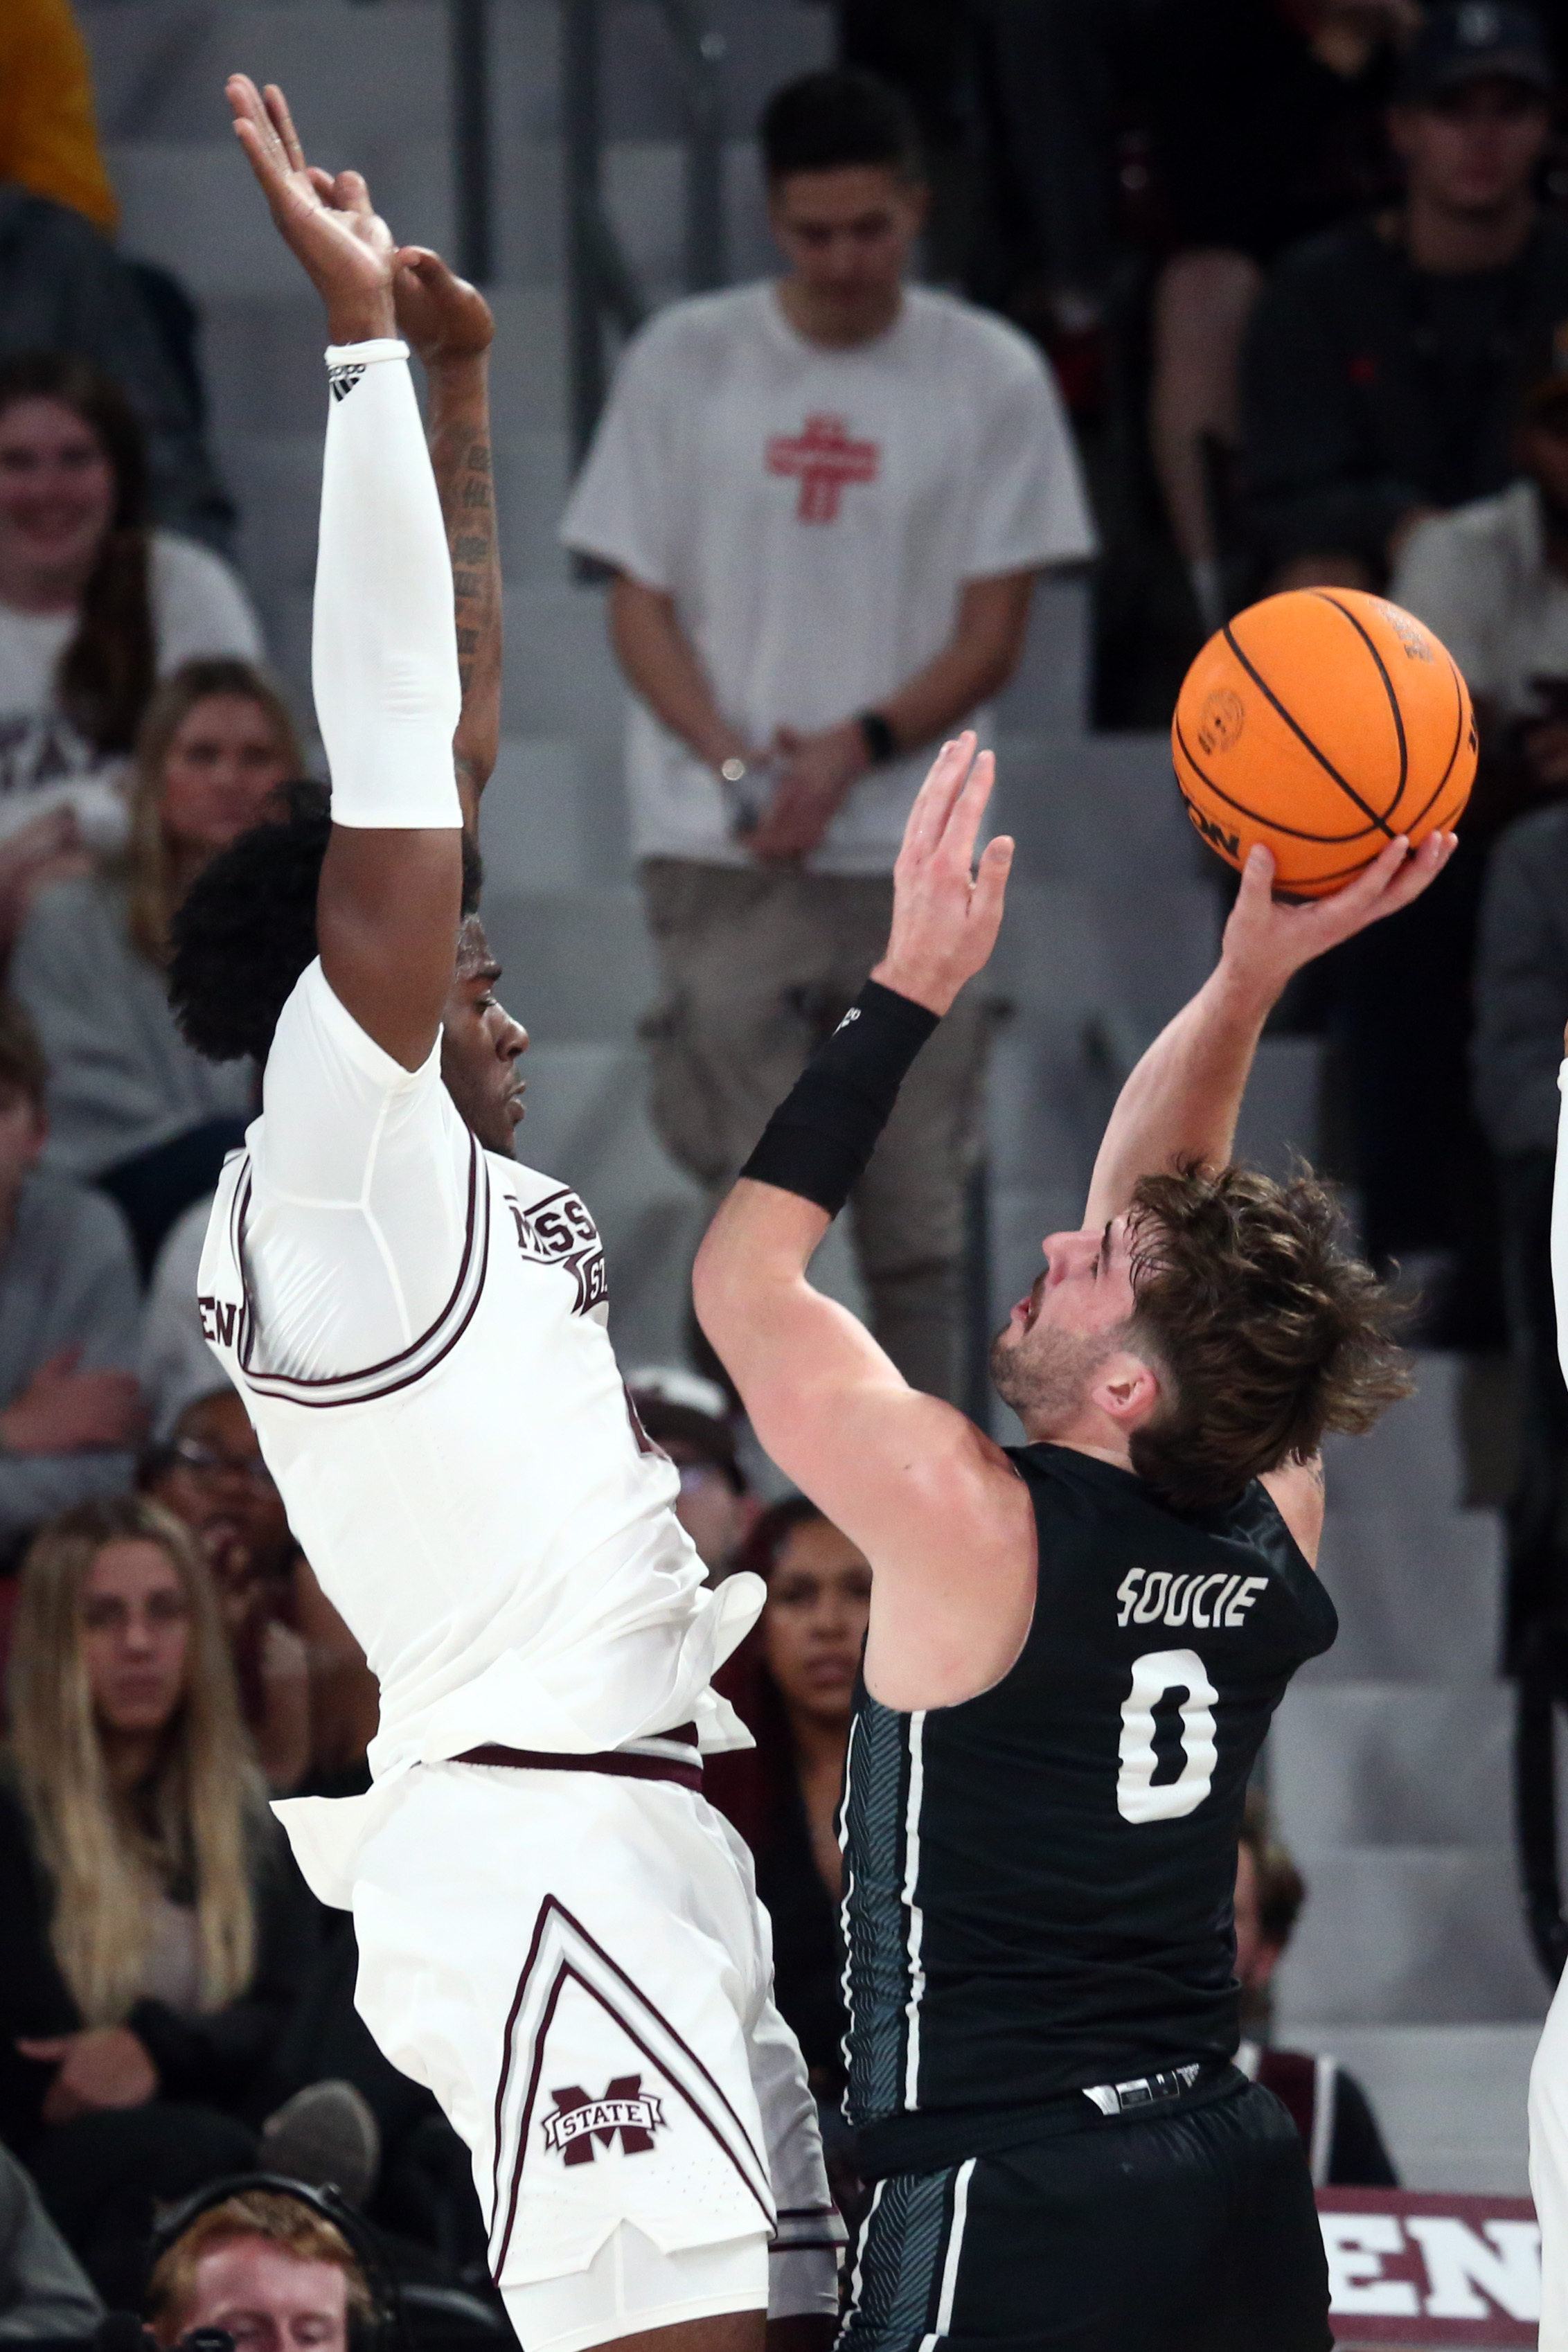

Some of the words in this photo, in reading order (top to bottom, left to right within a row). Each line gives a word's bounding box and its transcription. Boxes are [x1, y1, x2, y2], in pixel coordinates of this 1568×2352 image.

[1116, 1567, 1269, 1629] SOUCIE
[1116, 1648, 1219, 1824] 0
[562, 2104, 643, 2137] STATE
[1317, 2212, 1542, 2322] EN
